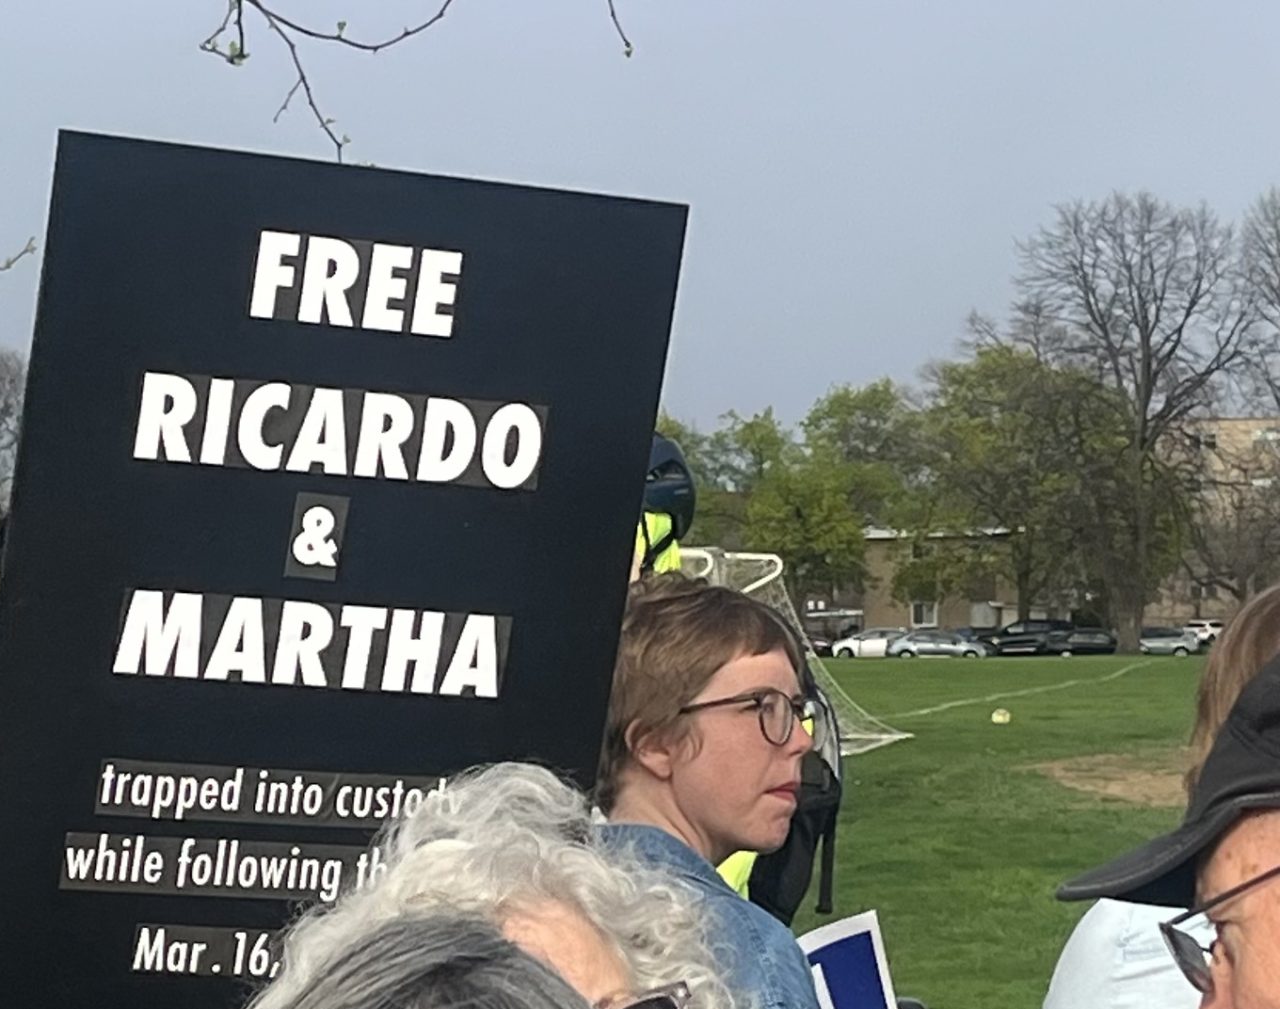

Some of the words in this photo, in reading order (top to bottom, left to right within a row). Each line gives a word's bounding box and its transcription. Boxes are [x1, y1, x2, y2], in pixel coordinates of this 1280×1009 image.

[250, 230, 463, 337] FREE
[133, 372, 542, 489] RICARDO
[292, 506, 338, 567] &
[112, 589, 498, 698] MARTHA
[101, 764, 243, 820] trapped
[254, 769, 323, 815] into
[66, 833, 164, 884] while
[176, 838, 342, 900] following
